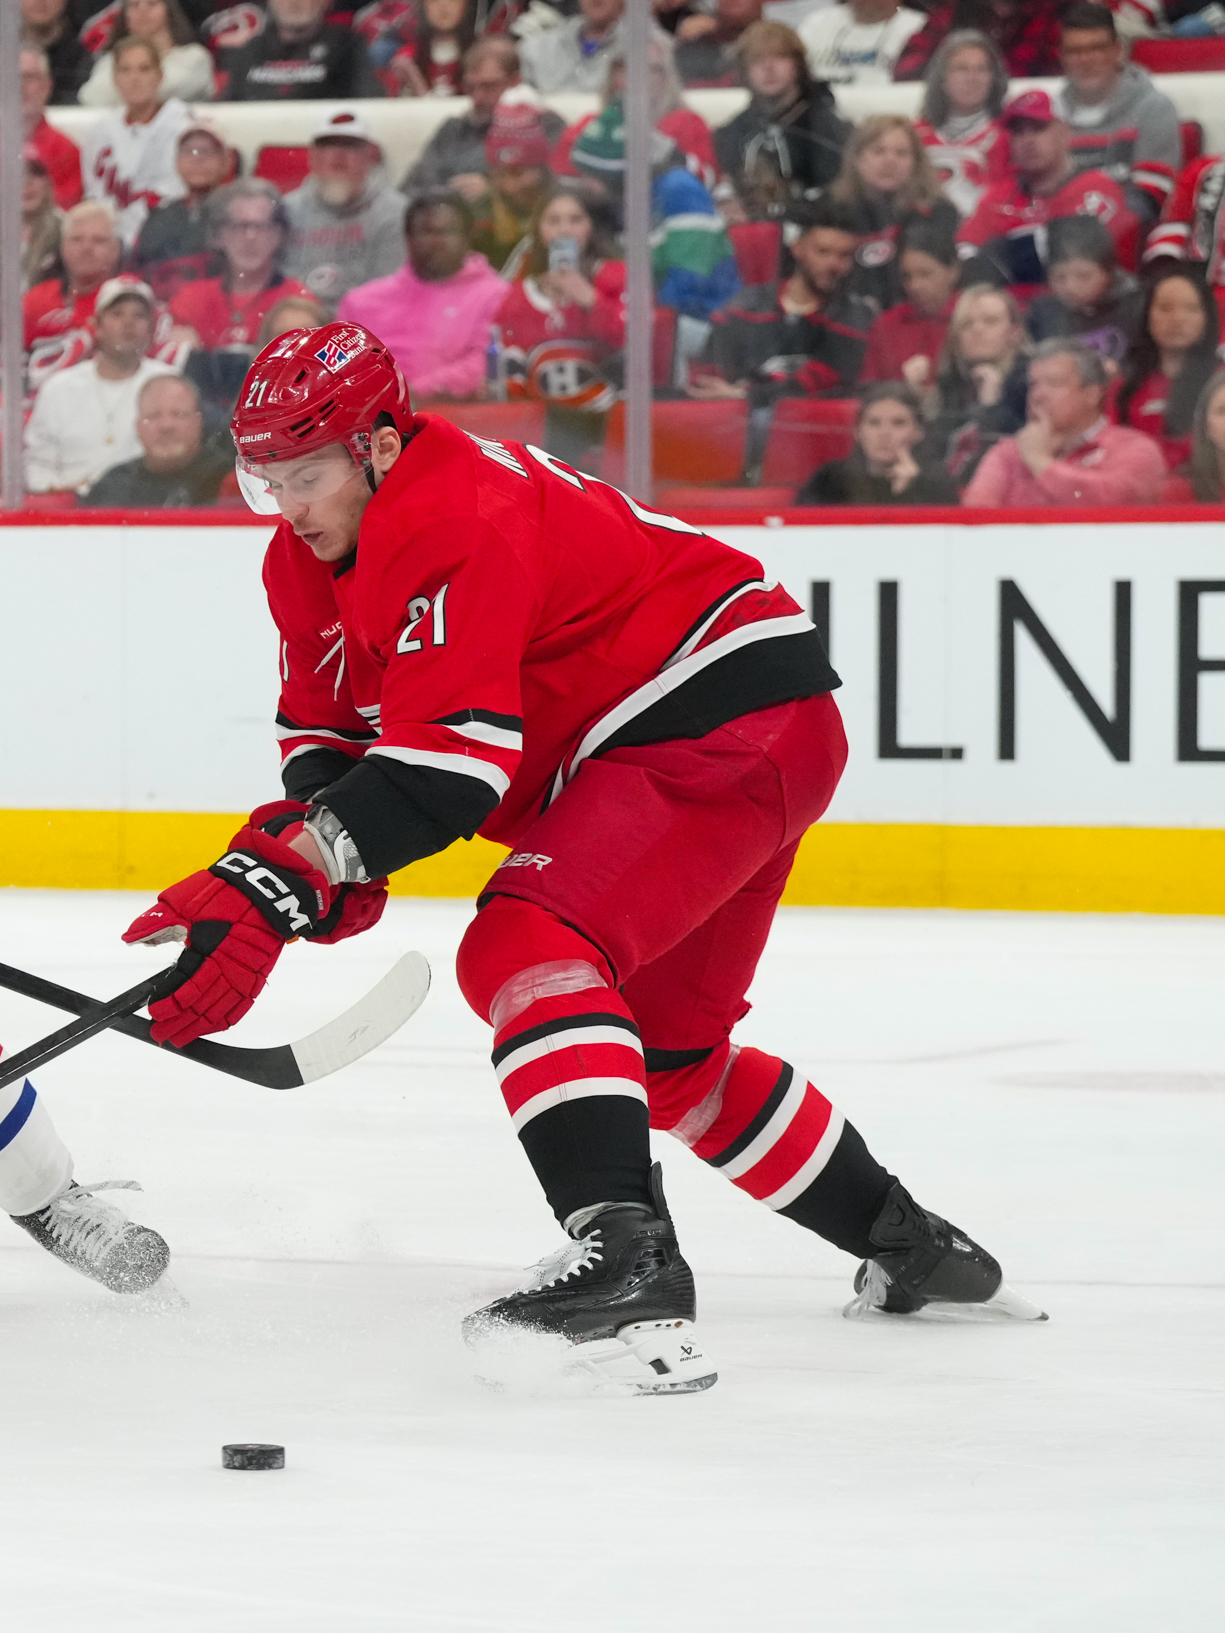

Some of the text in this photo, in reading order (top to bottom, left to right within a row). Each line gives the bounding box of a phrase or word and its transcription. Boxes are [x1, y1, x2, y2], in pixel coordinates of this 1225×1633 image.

[331, 330, 349, 344] First
[244, 380, 268, 409] 21
[239, 432, 272, 443] BAUER
[396, 582, 450, 655] 21
[216, 851, 313, 932] CCM
